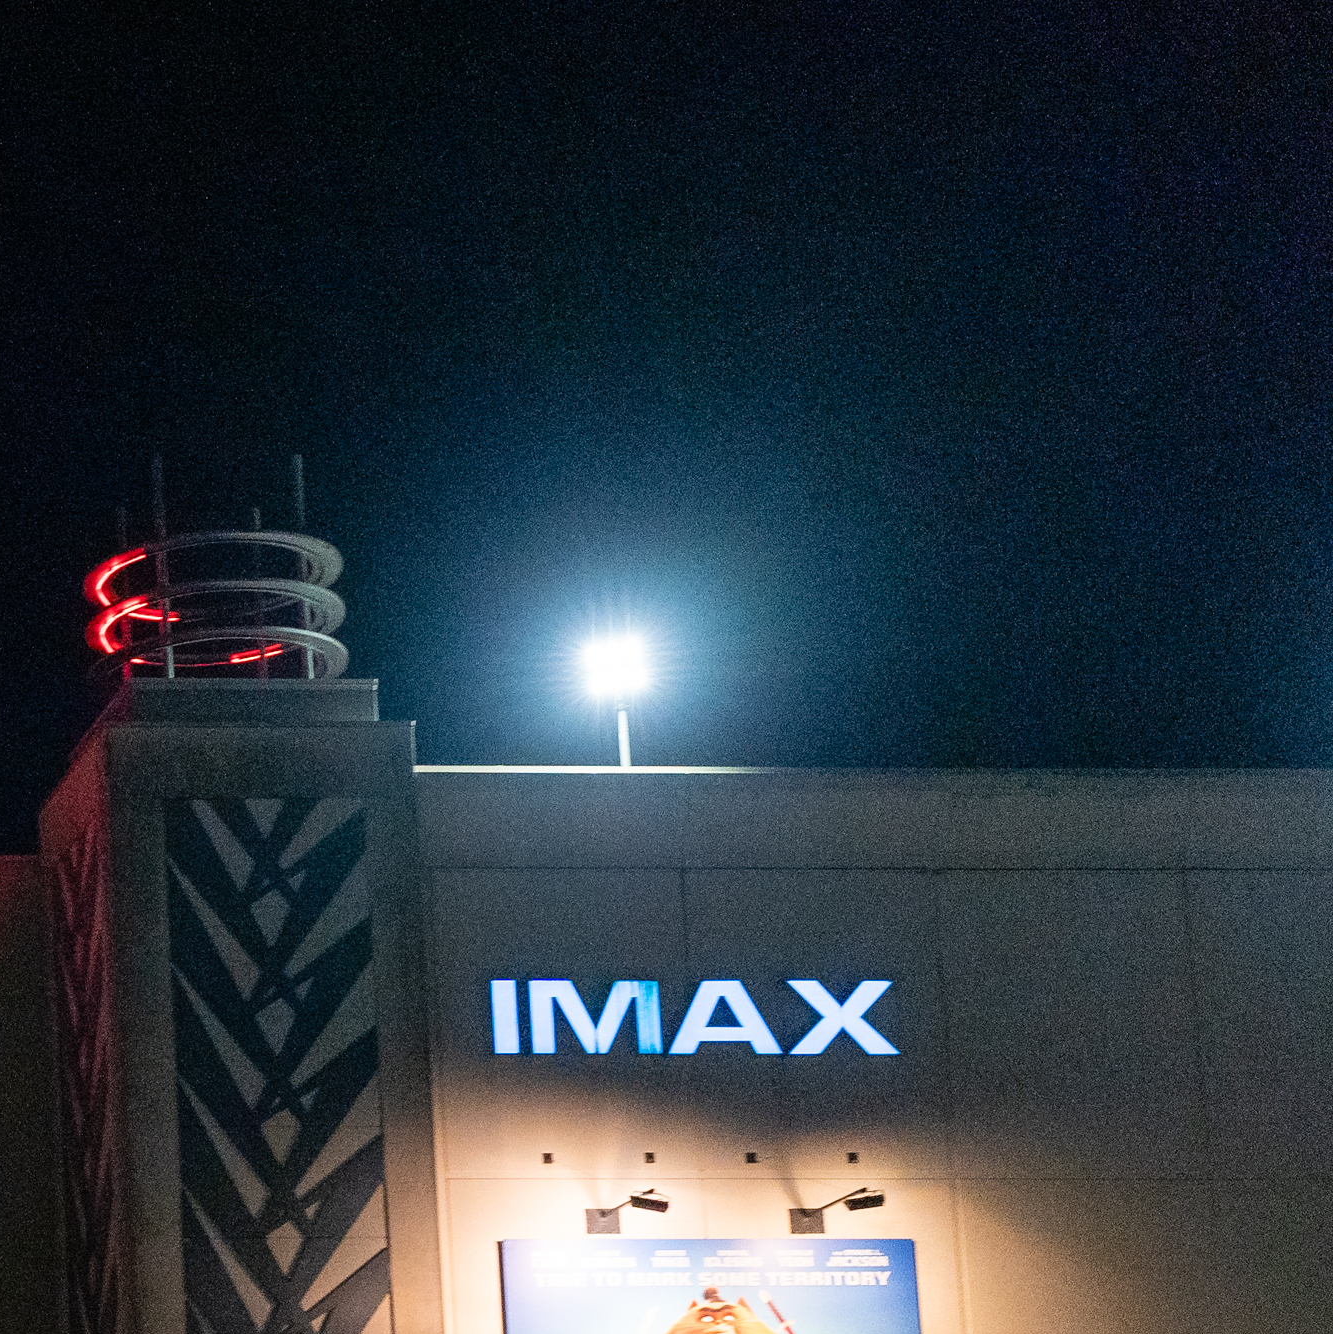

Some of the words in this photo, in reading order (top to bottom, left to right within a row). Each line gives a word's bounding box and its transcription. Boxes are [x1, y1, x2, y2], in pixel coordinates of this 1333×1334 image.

[490, 979, 901, 1055] IMAX
[591, 1272, 622, 1286] TO
[697, 1272, 761, 1287] SOME
[765, 1271, 891, 1286] TERRITORY
